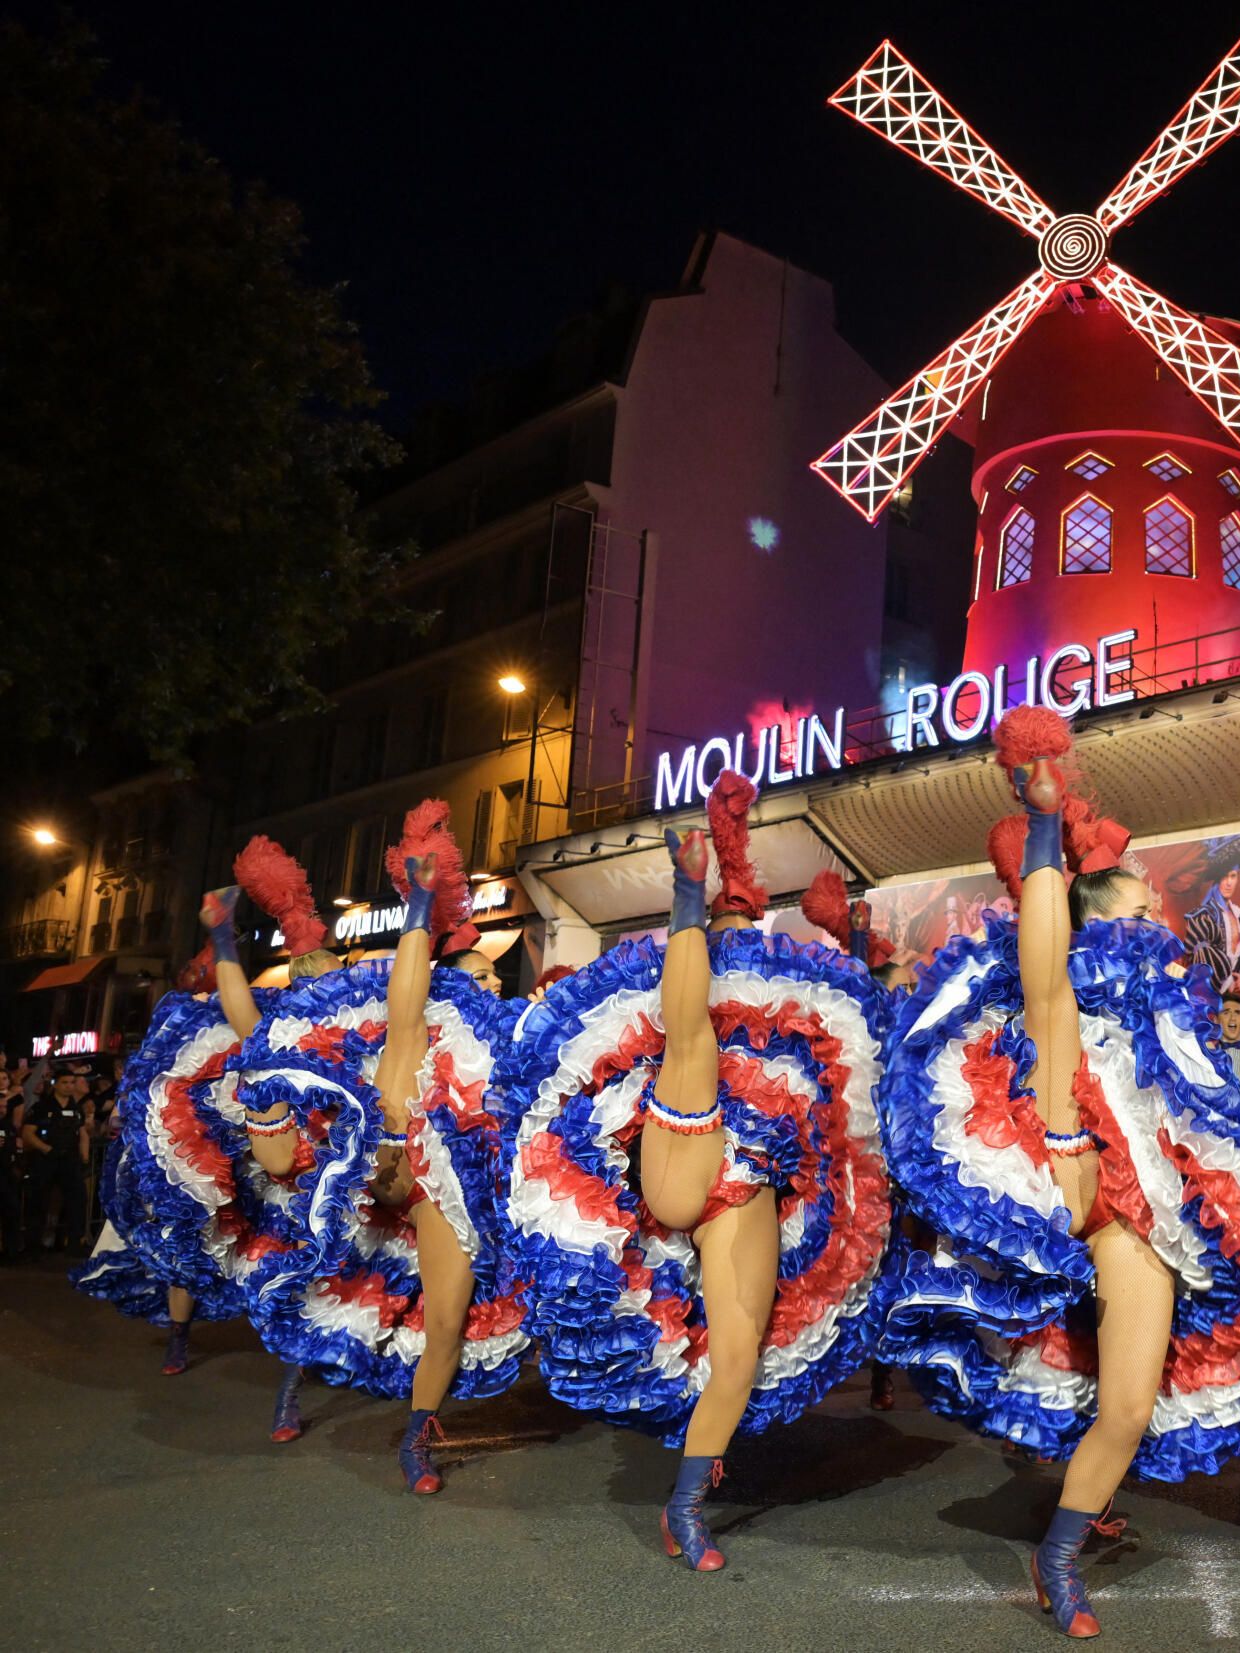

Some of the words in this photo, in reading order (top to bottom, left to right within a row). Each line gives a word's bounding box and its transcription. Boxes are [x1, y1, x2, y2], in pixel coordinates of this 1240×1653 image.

[654, 706, 845, 811] MOULIN
[904, 628, 1138, 752] ROUGE
[335, 903, 410, 940] O'SULLIVA
